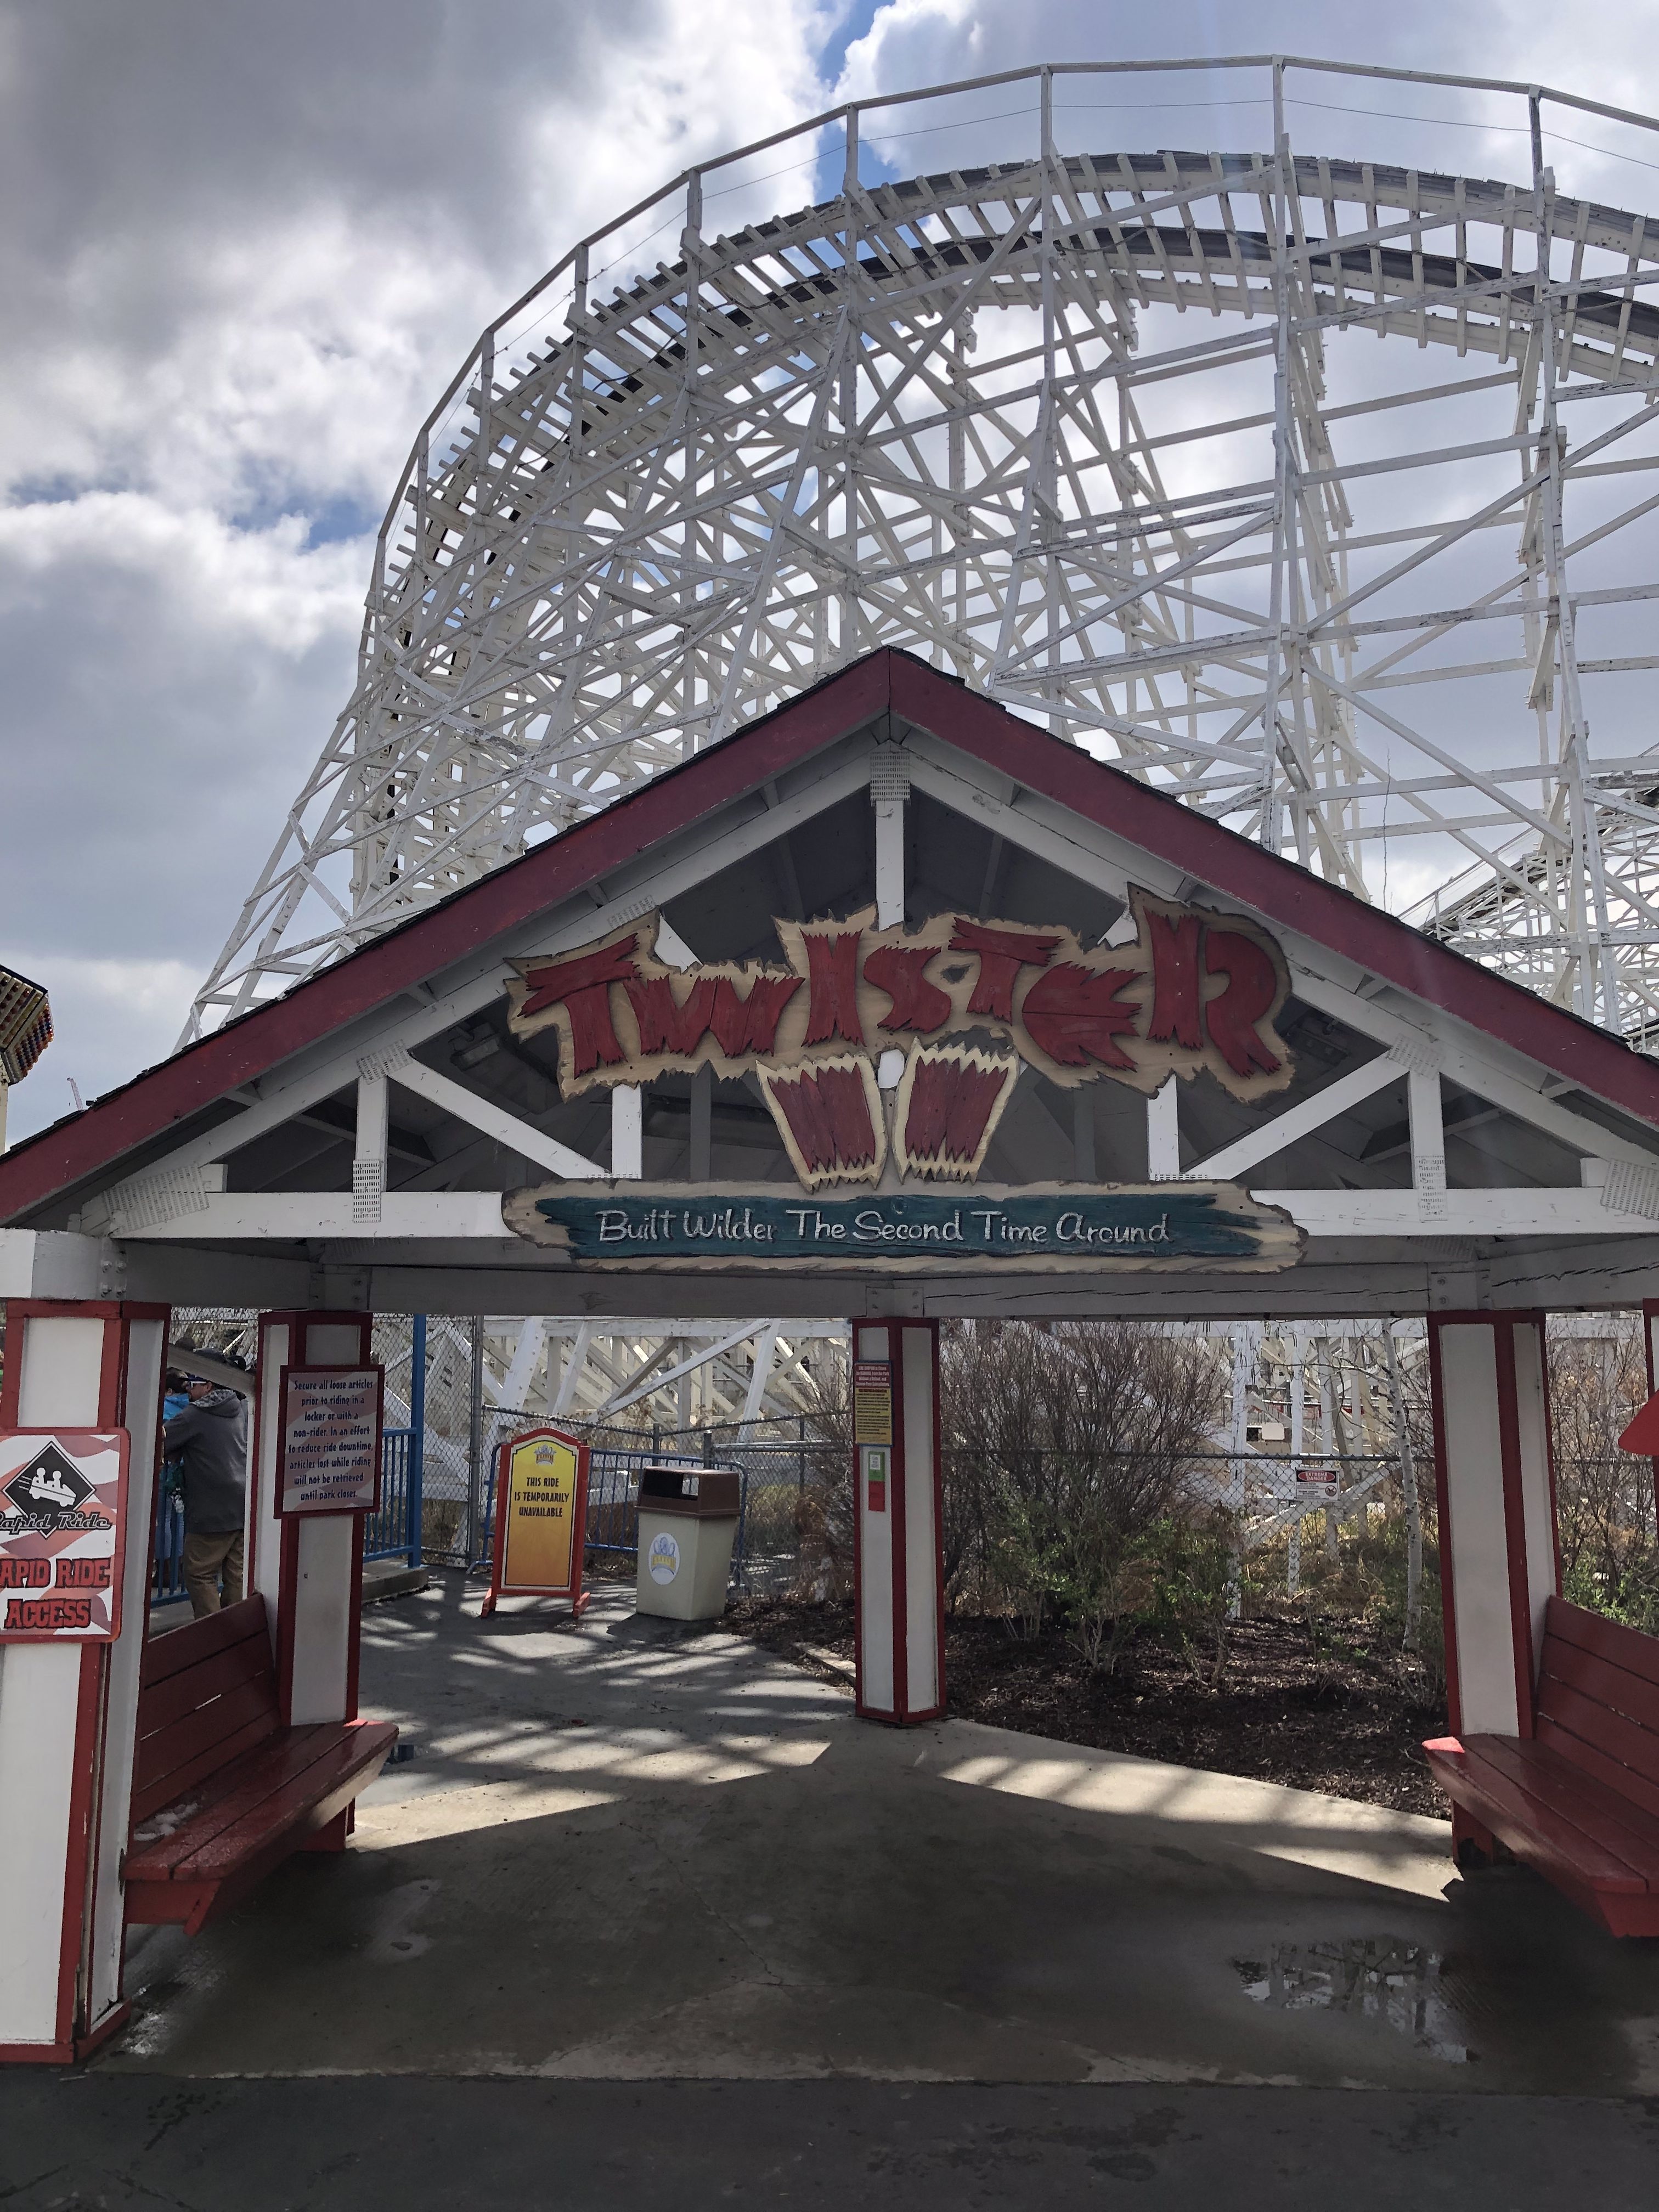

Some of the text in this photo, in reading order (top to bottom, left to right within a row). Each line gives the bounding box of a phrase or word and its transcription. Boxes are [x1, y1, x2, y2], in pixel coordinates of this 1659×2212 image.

[518, 907, 1282, 1079] TWISTER
[595, 1208, 1170, 1244] Built Wilder The Second Time Around
[294, 1378, 373, 1390] Secure all loose articles
[302, 1396, 319, 1407] prior
[321, 1396, 328, 1405] to
[330, 1395, 350, 1406] riding
[352, 1395, 358, 1404] in
[304, 1411, 326, 1421] locker
[337, 1410, 352, 1420] with
[294, 1427, 328, 1437] non-rider.
[330, 1426, 337, 1436] In
[350, 1425, 370, 1435] effort
[289, 1441, 374, 1453] to reduce ride downtime,
[290, 1456, 371, 1469] articles lost while riding
[294, 1472, 364, 1485] will not be retrieved
[527, 1477, 559, 1487] THIS RIDE
[301, 1488, 358, 1501] until park closes.
[514, 1492, 569, 1502] IS TEMPORARILY
[519, 1506, 563, 1517] UNAVAILABLE
[57, 1511, 112, 1530] Ride
[0, 1557, 110, 1588] APID RIDE
[4, 1599, 92, 1628] ACCESS
